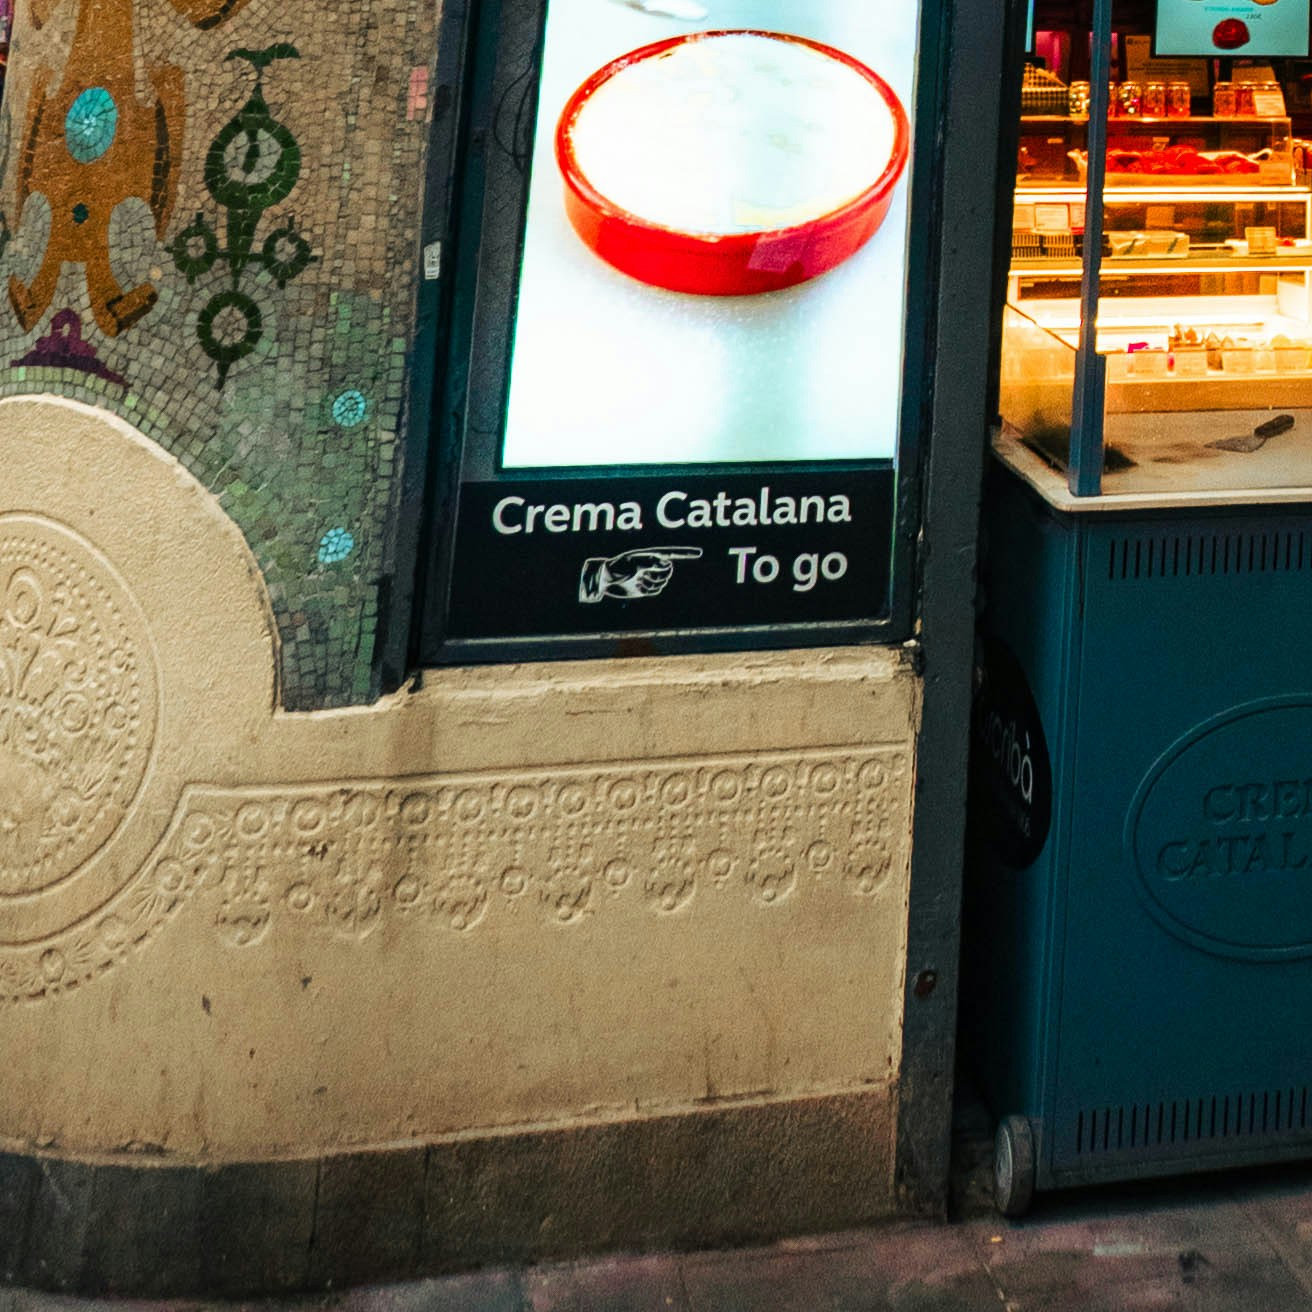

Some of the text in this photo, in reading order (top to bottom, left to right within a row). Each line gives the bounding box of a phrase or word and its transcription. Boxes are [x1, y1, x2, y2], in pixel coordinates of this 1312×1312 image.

[492, 487, 853, 535] Crema Catalana
[728, 546, 849, 592] To go
